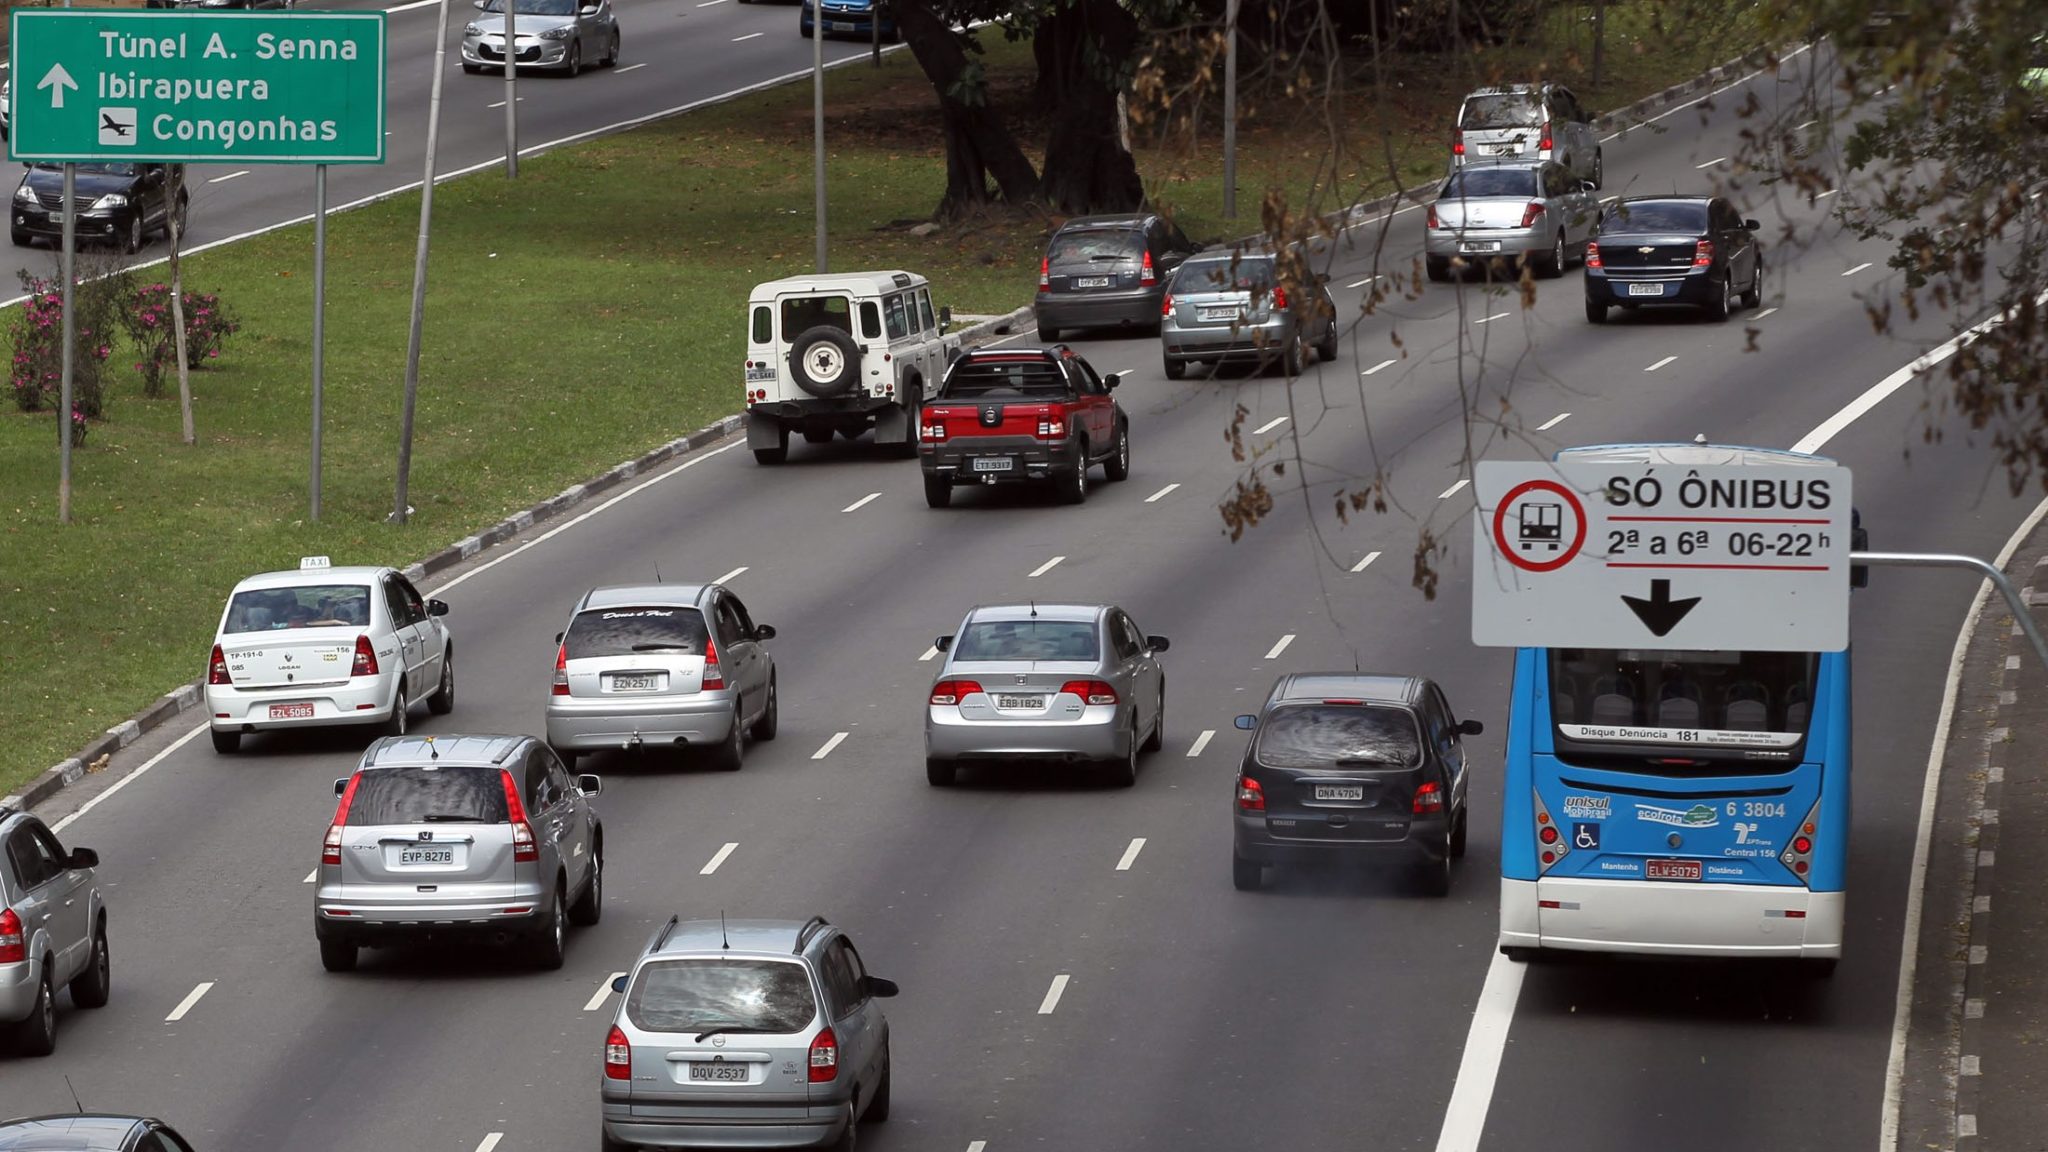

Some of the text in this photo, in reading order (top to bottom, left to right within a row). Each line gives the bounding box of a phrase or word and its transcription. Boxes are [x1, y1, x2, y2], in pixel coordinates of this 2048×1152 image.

[99, 31, 358, 60] Túnel A. Senna
[98, 71, 269, 104] Ibirapuera
[152, 113, 338, 150] Congonhas
[1607, 468, 1832, 510] SÓ ÔNIBUS
[1649, 535, 1667, 555] a
[304, 557, 328, 567] TAXI
[231, 664, 245, 672] 085
[1580, 726, 1616, 738] Disque
[1619, 727, 1669, 740] Denúncia
[1675, 730, 1700, 742] 181
[1566, 796, 1610, 809] unisul
[1637, 809, 1683, 825] ecofrota
[1726, 802, 1737, 816] 6
[1743, 802, 1786, 818] 3804
[401, 851, 452, 863] EVP-8278
[1724, 847, 1776, 858] Central 156
[1601, 862, 1639, 872] Mantenha
[1648, 865, 1700, 878] ELW-5079
[1707, 865, 1744, 875] Distância
